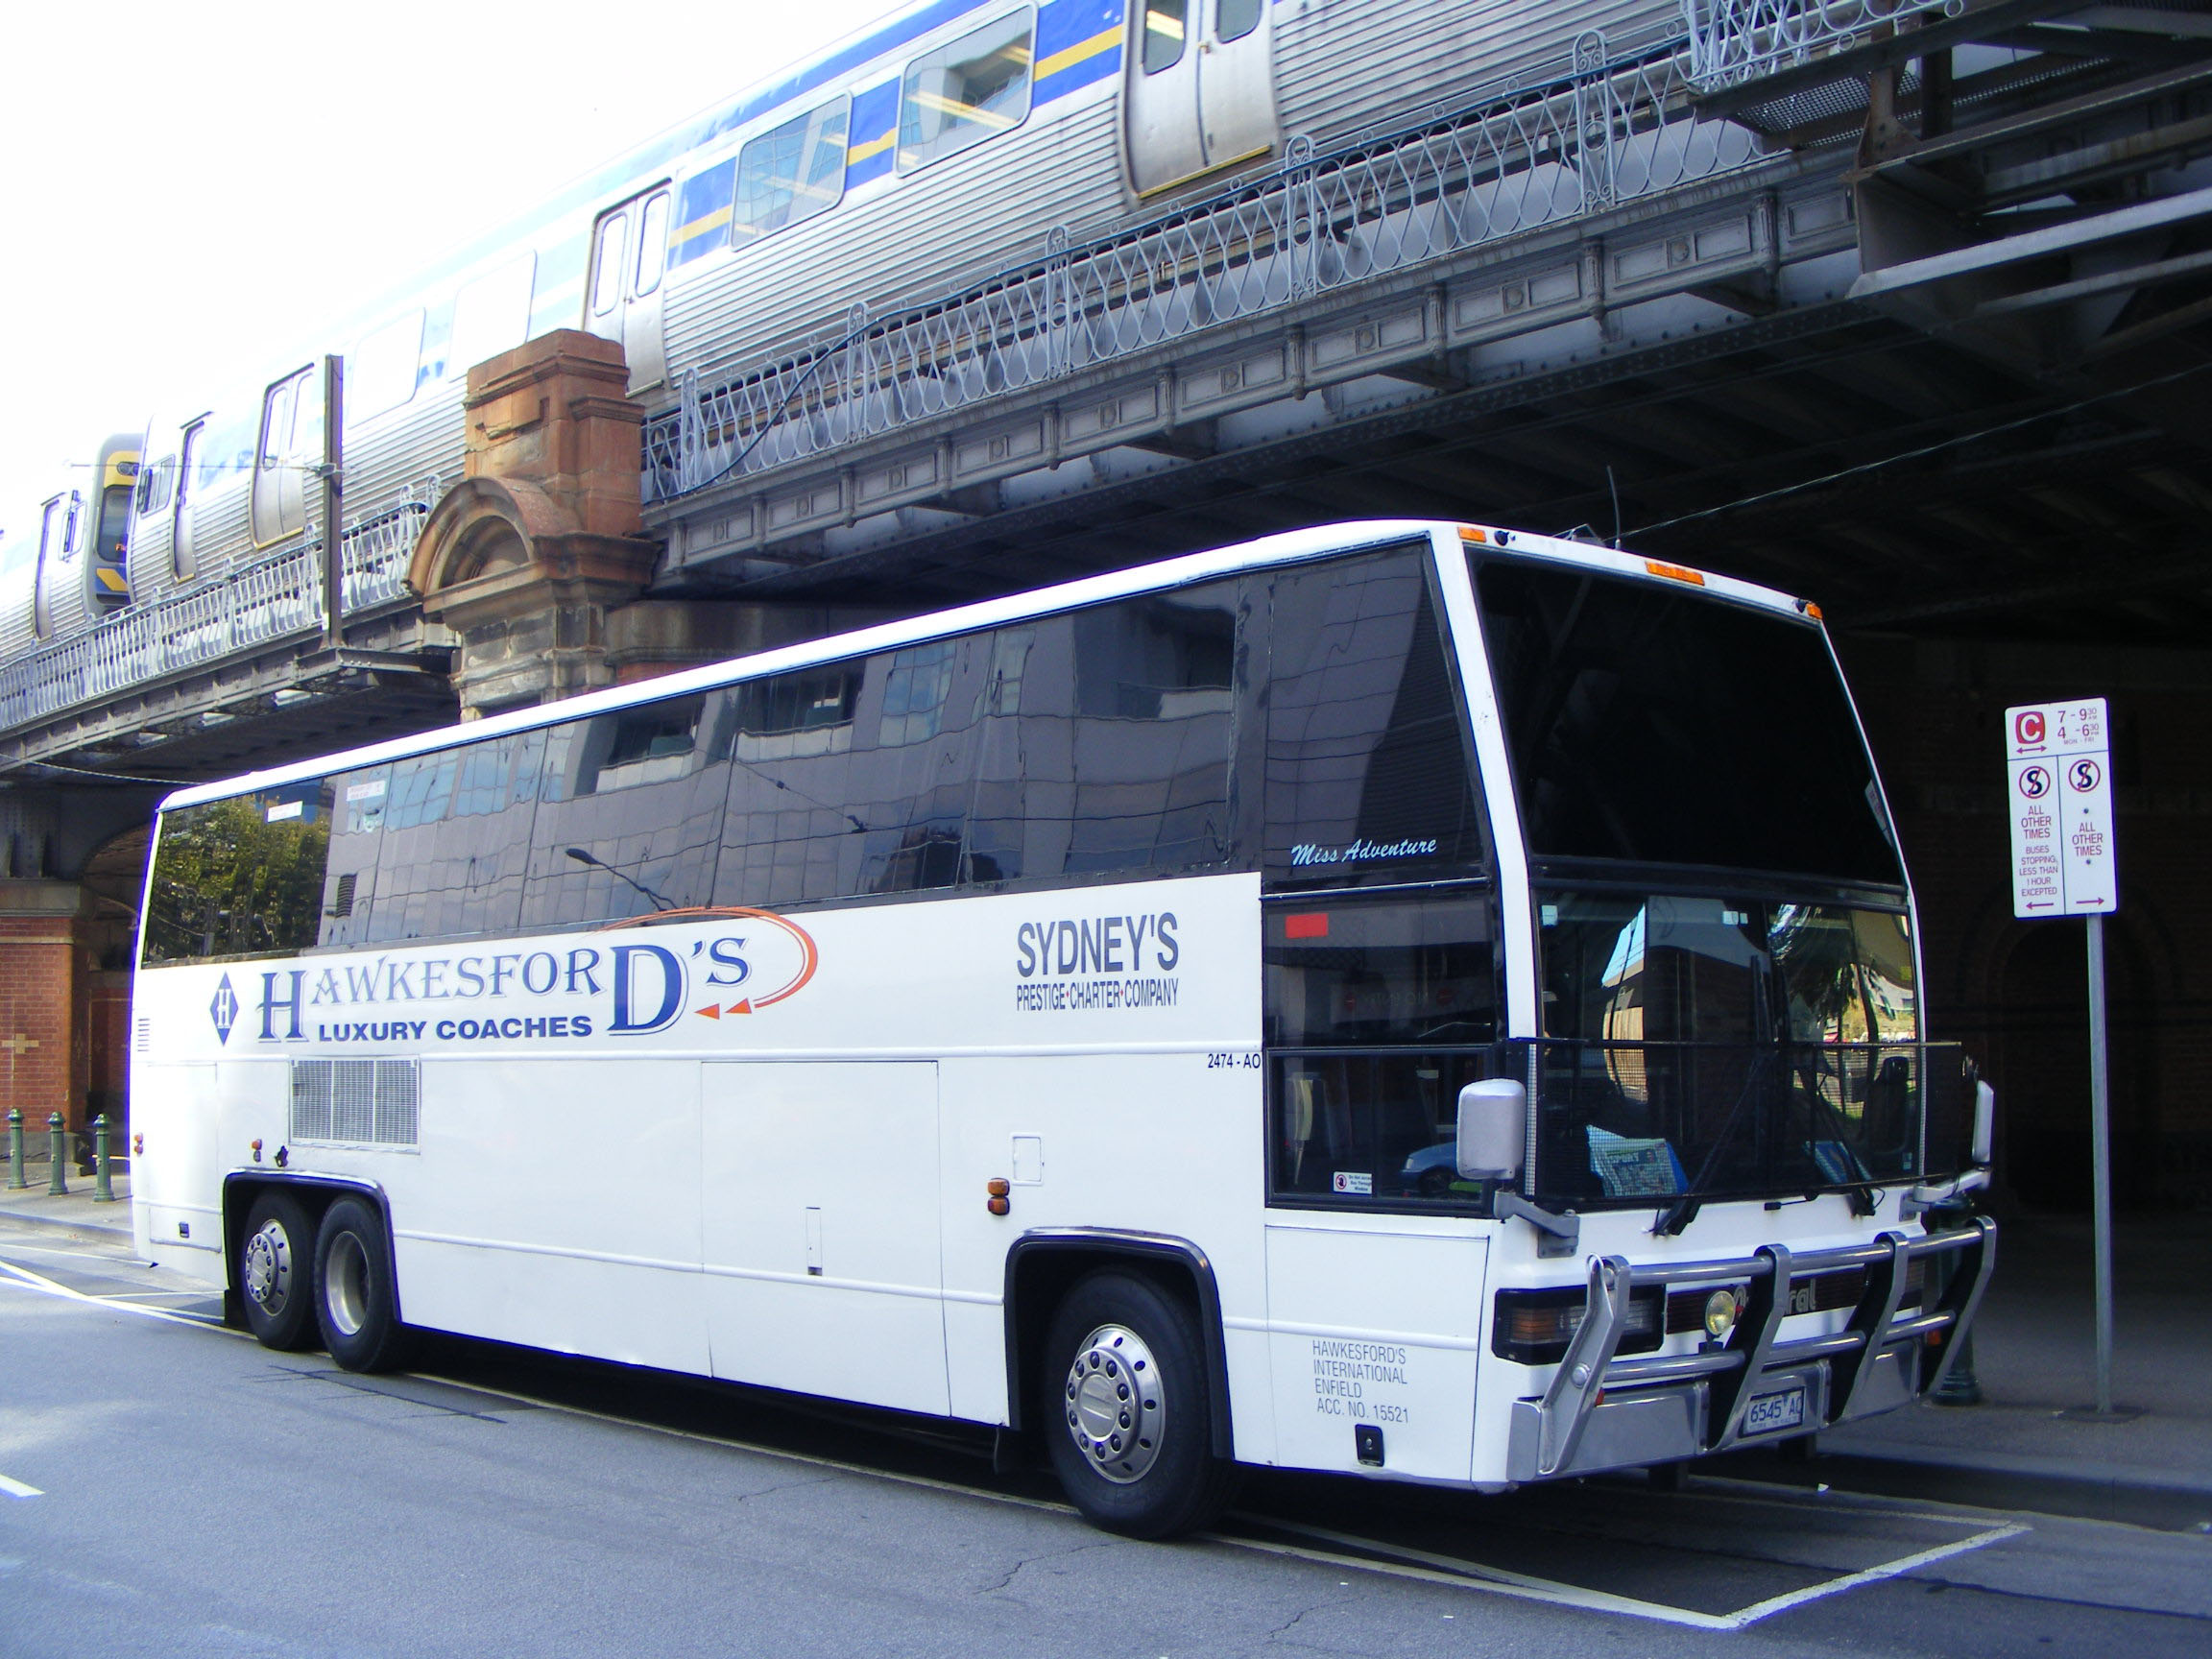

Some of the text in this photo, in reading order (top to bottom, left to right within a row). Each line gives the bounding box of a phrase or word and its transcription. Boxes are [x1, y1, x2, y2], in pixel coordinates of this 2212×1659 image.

[2028, 805, 2044, 815] ALL
[2021, 816, 2052, 828] OTHER
[2079, 822, 2096, 832] ALL
[2024, 828, 2051, 839] TIMES
[2072, 833, 2104, 845] OTHER
[1290, 838, 1437, 866] Miss Adventure
[2026, 845, 2050, 854] BUSES
[2075, 845, 2103, 856] TIMES
[2019, 865, 2058, 876] LESS THAN
[2031, 877, 2052, 885] HOUR
[2021, 887, 2057, 897] EXCEPTED
[1017, 912, 1179, 978] SYDNEY'S
[255, 937, 752, 1044] HAWKESFORD'S
[1017, 977, 1179, 1011] PRESTIGE CHARTER COMPANY
[319, 1016, 593, 1042] LUXURY COACHES
[1208, 1053, 1234, 1069] 2474
[1312, 1340, 1407, 1364] HAWKESFORD'S
[1313, 1359, 1408, 1384] INTERNATIONAL
[1314, 1378, 1362, 1399] ENFIELD
[1317, 1397, 1408, 1423] ACC. NO. 15521
[1750, 1400, 1782, 1424] 6545
